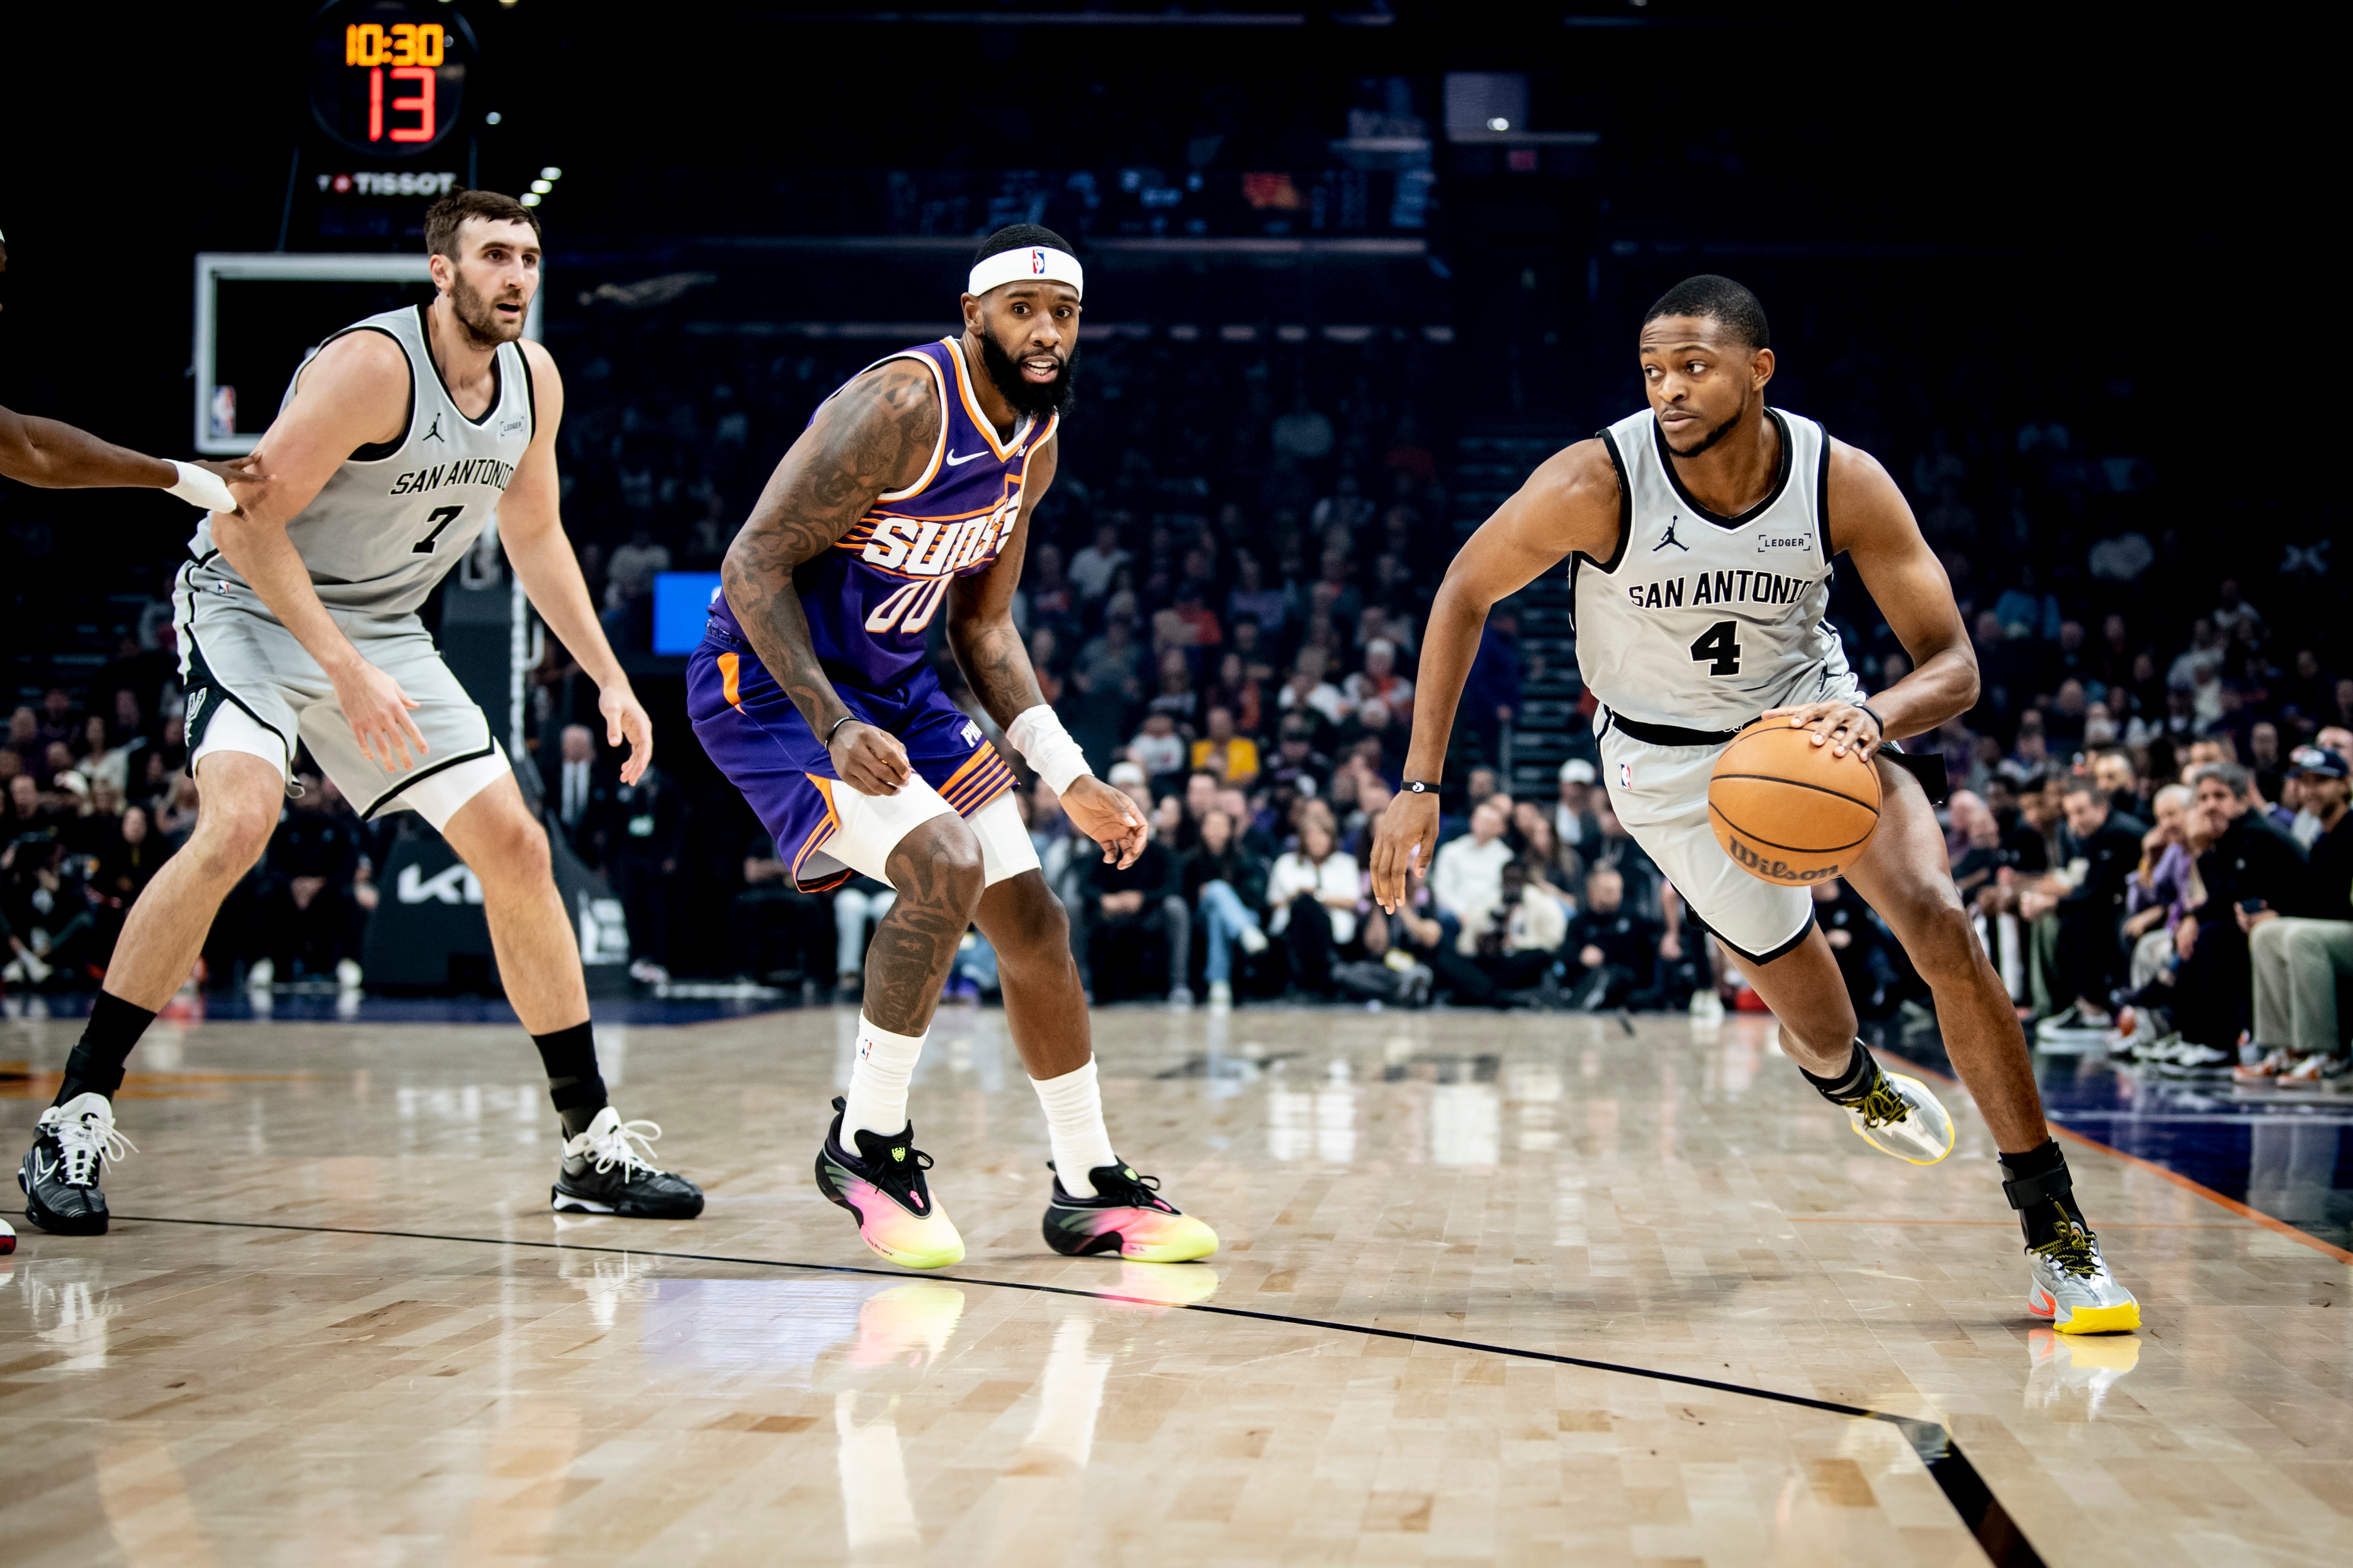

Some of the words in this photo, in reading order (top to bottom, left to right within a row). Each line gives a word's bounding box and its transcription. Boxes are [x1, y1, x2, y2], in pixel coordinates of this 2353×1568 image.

[346, 24, 444, 66] 10:30
[369, 66, 436, 142] 13
[353, 171, 457, 196] TISSOT
[389, 463, 447, 496] SAN
[411, 504, 467, 555] 7
[1765, 538, 1804, 548] LEDGER
[865, 571, 954, 634] 00
[1629, 575, 1686, 609] SAN
[1688, 620, 1743, 678] 4
[1729, 834, 1839, 881] Wilson
